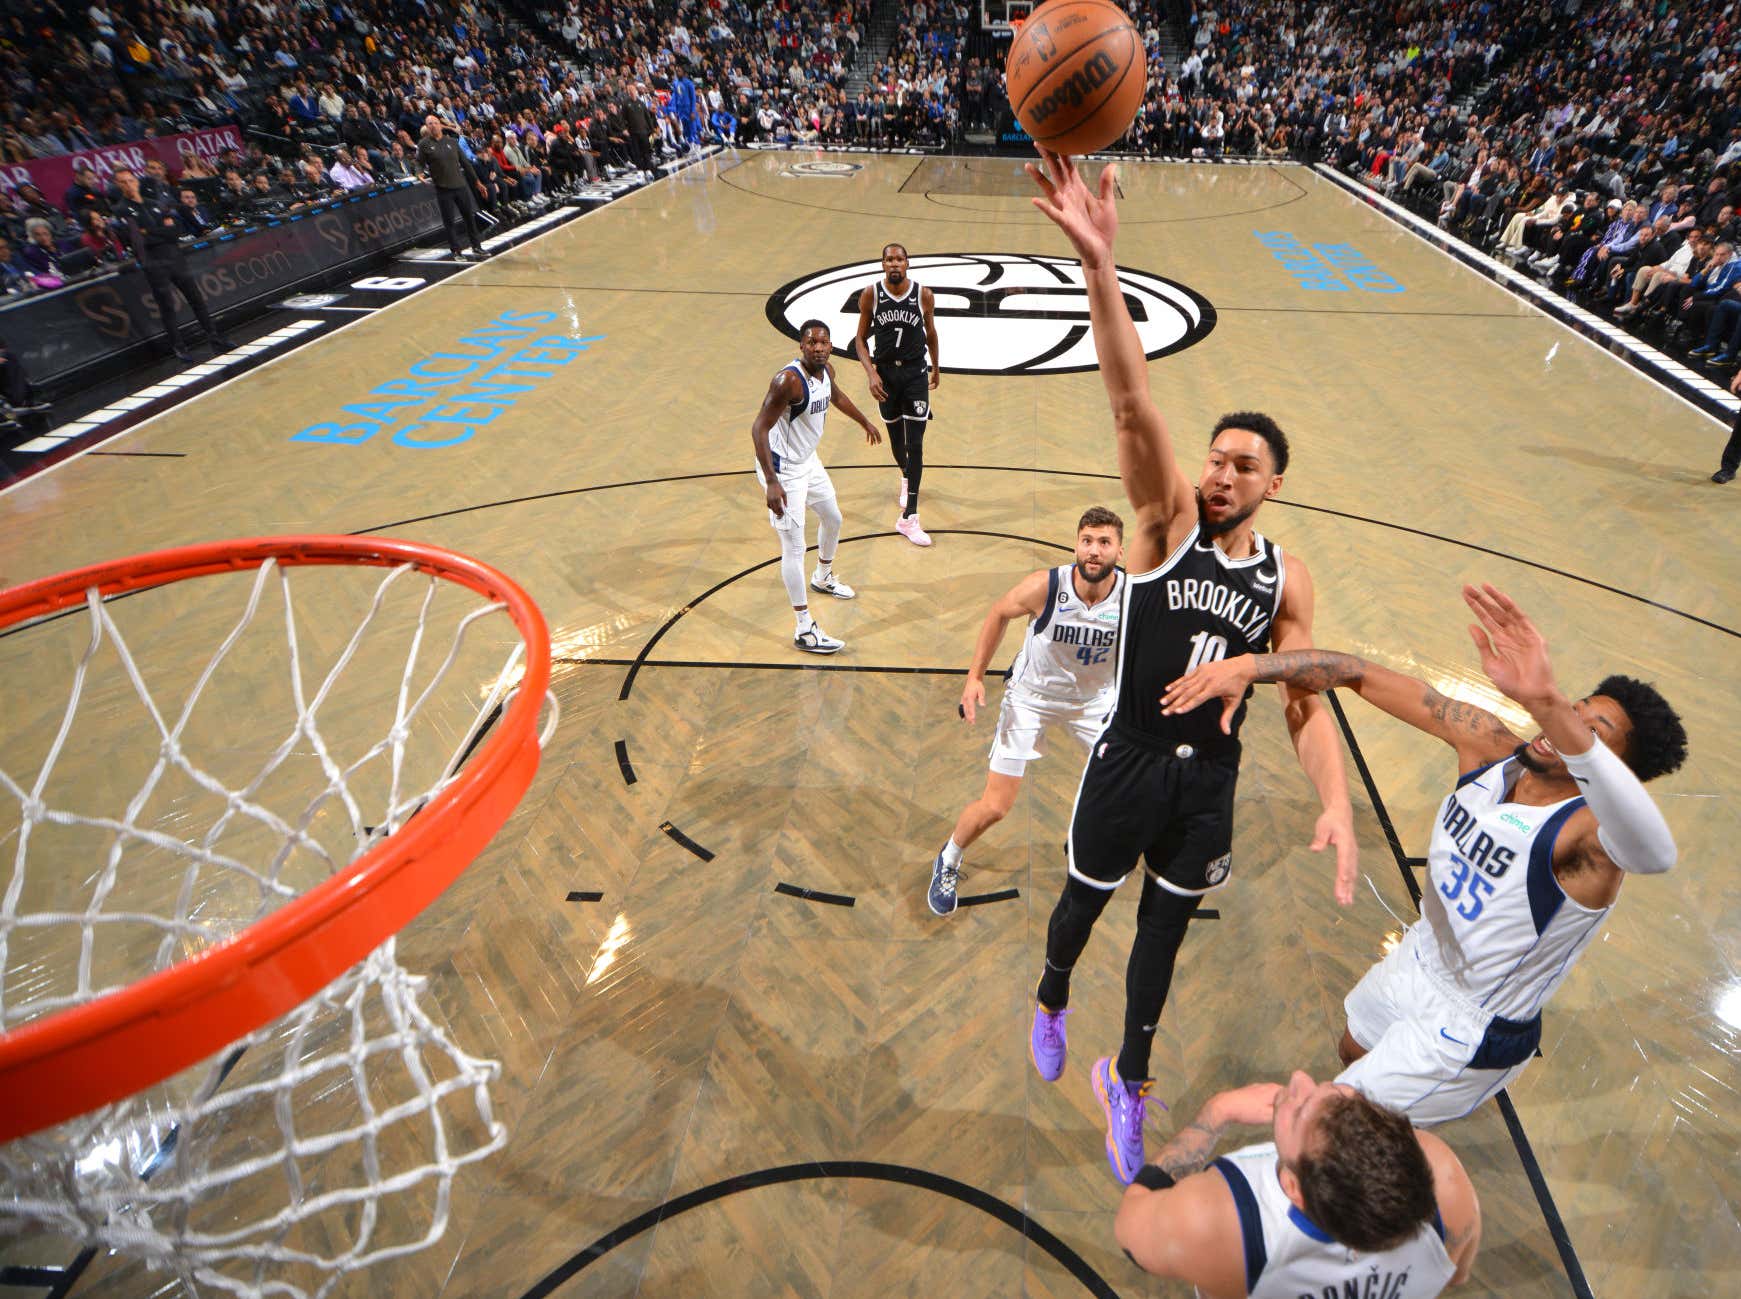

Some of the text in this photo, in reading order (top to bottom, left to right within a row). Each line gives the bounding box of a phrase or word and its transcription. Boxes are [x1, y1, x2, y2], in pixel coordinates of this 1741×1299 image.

[1028, 50, 1118, 123] Wilson
[176, 131, 241, 156] QATAR
[72, 146, 147, 180] QATAR
[876, 309, 920, 328] BROOKLYN
[894, 327, 904, 348] 7
[288, 309, 559, 446] BARCLAYS
[391, 334, 608, 450] CENTER
[1166, 578, 1270, 644] BROOKLYN
[1053, 623, 1116, 647] DALLAS
[1076, 646, 1110, 666] 42
[1184, 630, 1228, 677] 10
[1499, 812, 1532, 833] chime
[1440, 853, 1496, 922] 35
[1297, 1264, 1413, 1299] ONČIĆ
